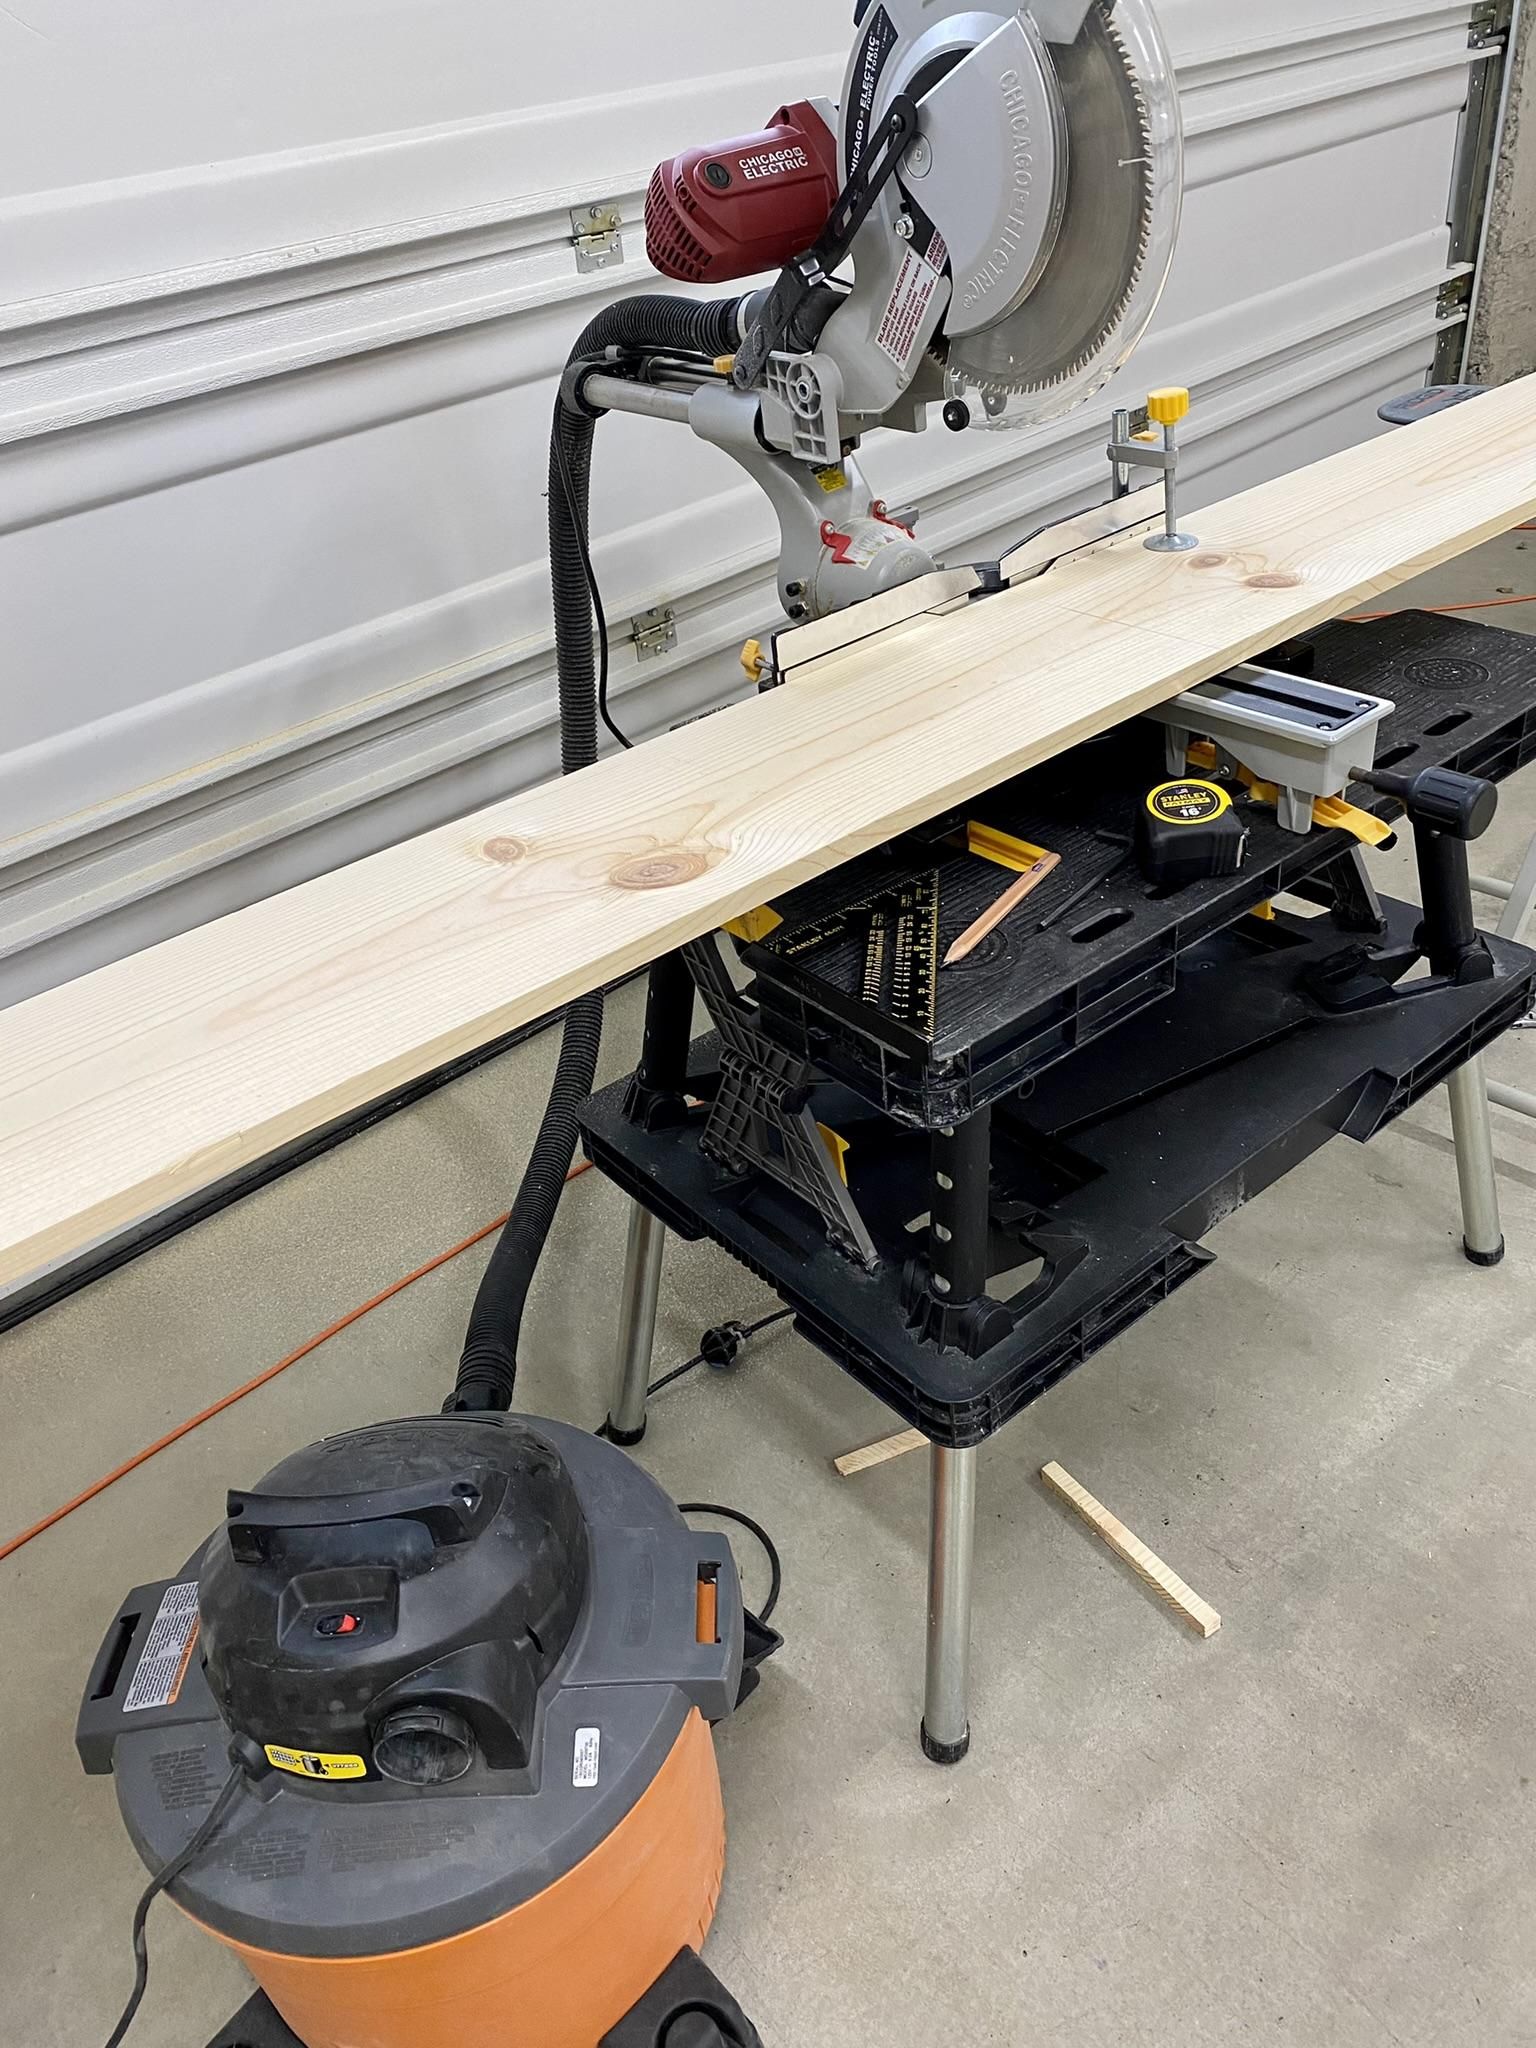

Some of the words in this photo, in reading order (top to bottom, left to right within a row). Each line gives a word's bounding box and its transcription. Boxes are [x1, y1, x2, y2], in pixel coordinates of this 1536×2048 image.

[865, 76, 875, 110] POWER
[871, 39, 880, 72] TOOLS
[849, 119, 864, 177] HICAGO
[860, 36, 876, 108] ELECTRIC
[999, 69, 1033, 185] CHICAGO
[738, 148, 794, 169] CHICAGO
[743, 156, 808, 180] ELECTRIC
[926, 231, 941, 261] ARBOR
[877, 315, 890, 343] BLADE
[887, 250, 913, 315] REPLACEMENT
[1160, 791, 1208, 804] STANLEY
[786, 935, 823, 955] STANLEY
